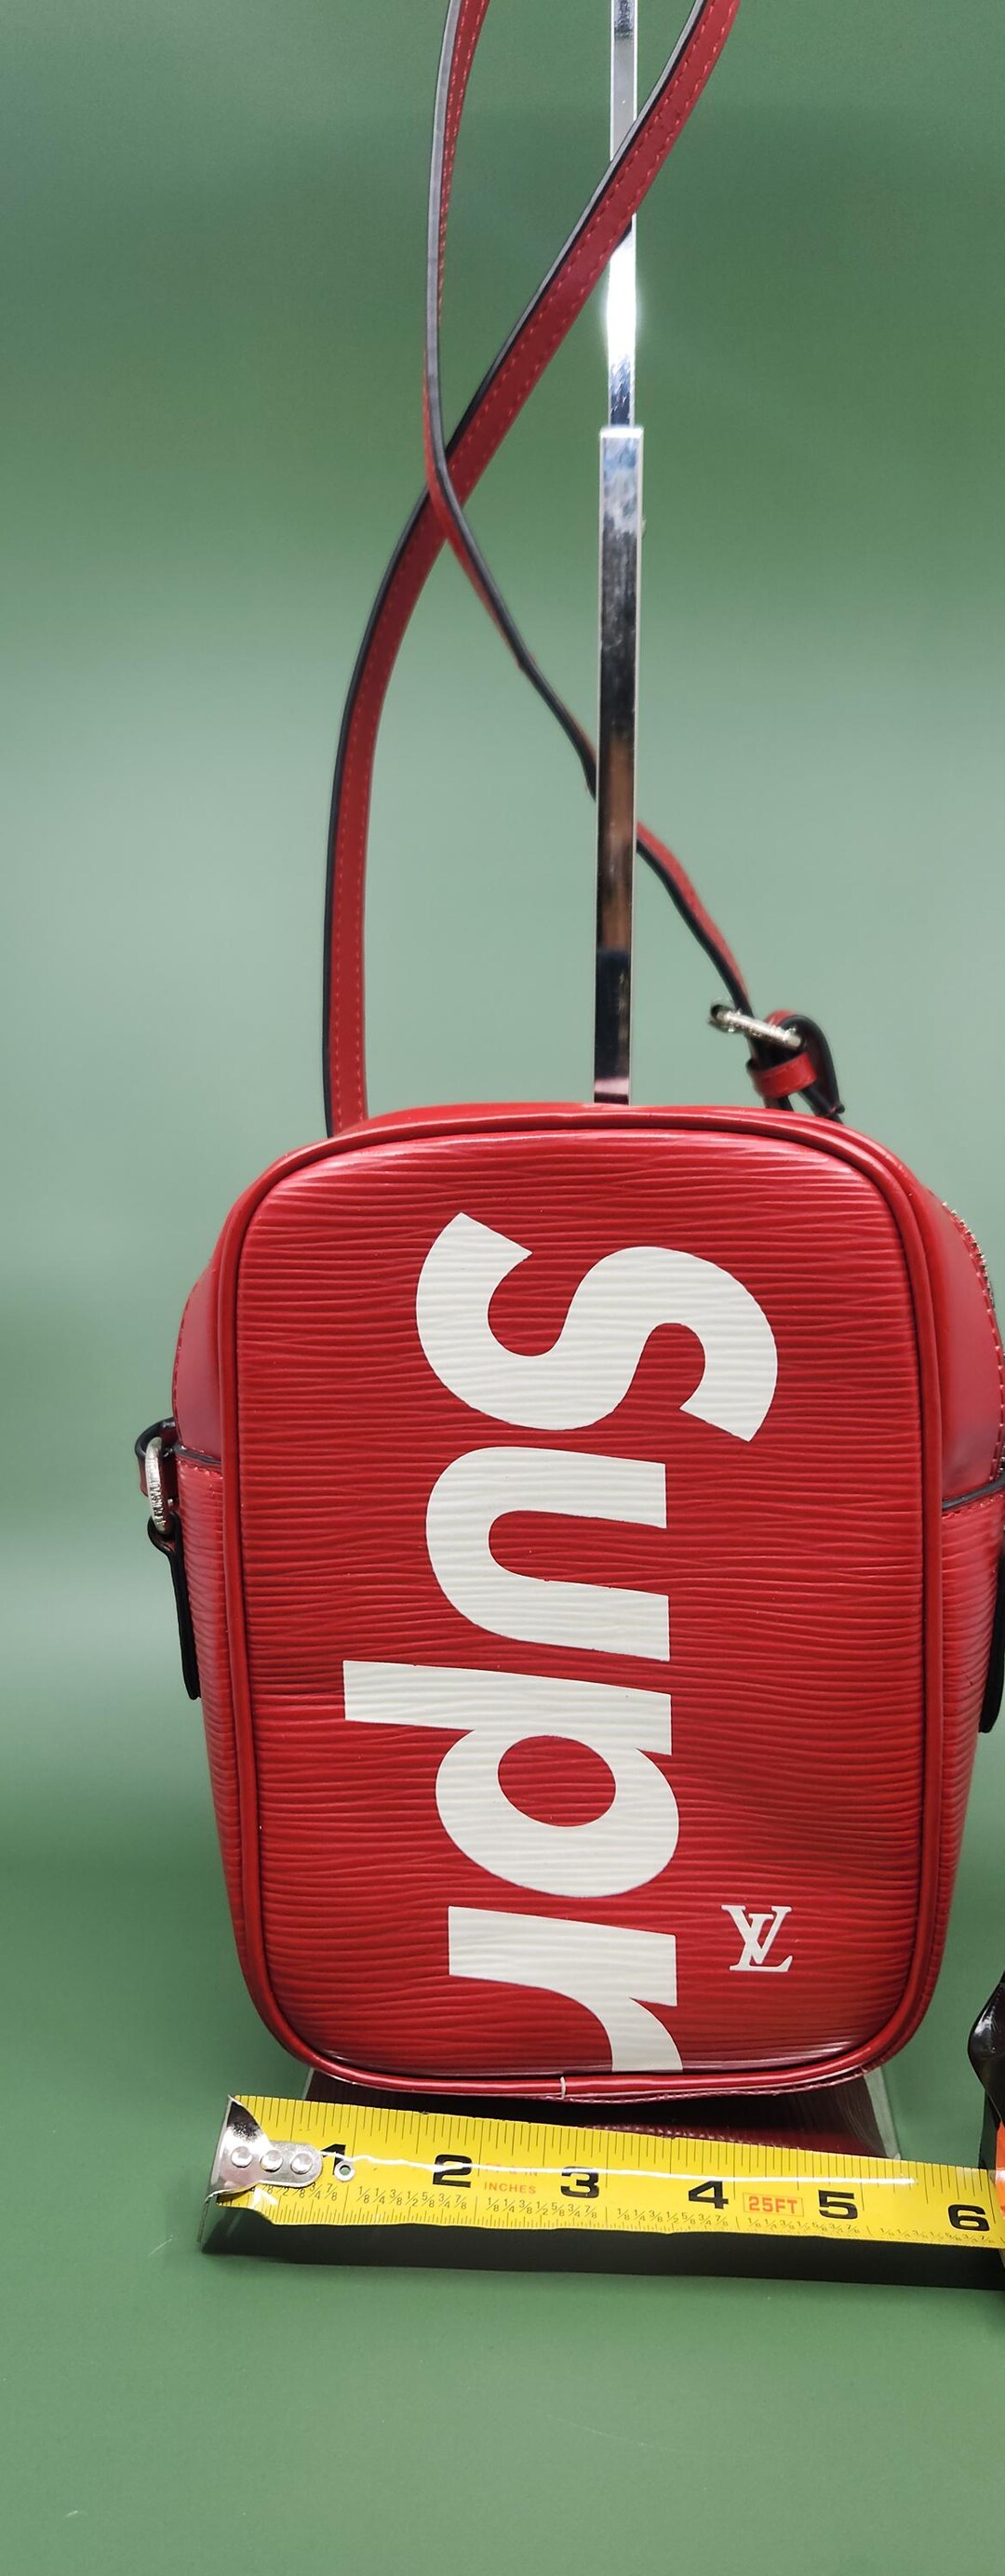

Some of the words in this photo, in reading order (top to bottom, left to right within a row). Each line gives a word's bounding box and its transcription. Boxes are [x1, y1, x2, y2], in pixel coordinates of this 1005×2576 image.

[343, 1212, 779, 2072] Supr
[320, 2143, 346, 2176] 1
[434, 2154, 473, 2188] 2
[560, 2166, 600, 2198] 3
[688, 2181, 729, 2209] 4
[818, 2189, 859, 2220] 5
[948, 2204, 990, 2232] 6
[356, 2186, 369, 2203] 1/8
[373, 2188, 386, 2204] 1/4
[389, 2189, 402, 2206] 3/8
[405, 2191, 419, 2207] 1/2
[421, 2192, 435, 2208] 5/8
[438, 2193, 450, 2209] 3/4
[454, 2194, 467, 2209] 7/8
[488, 2197, 500, 2212] 1/8
[503, 2198, 515, 2212] 1/4
[519, 2200, 532, 2214] 3/8
[536, 2201, 548, 2216] 1/2
[551, 2202, 565, 2217] 5/8
[569, 2204, 581, 2218] 3/4
[584, 2205, 597, 2219] 7/8
[484, 2181, 537, 2196] INCHES
[748, 2196, 797, 2215] 25FT
